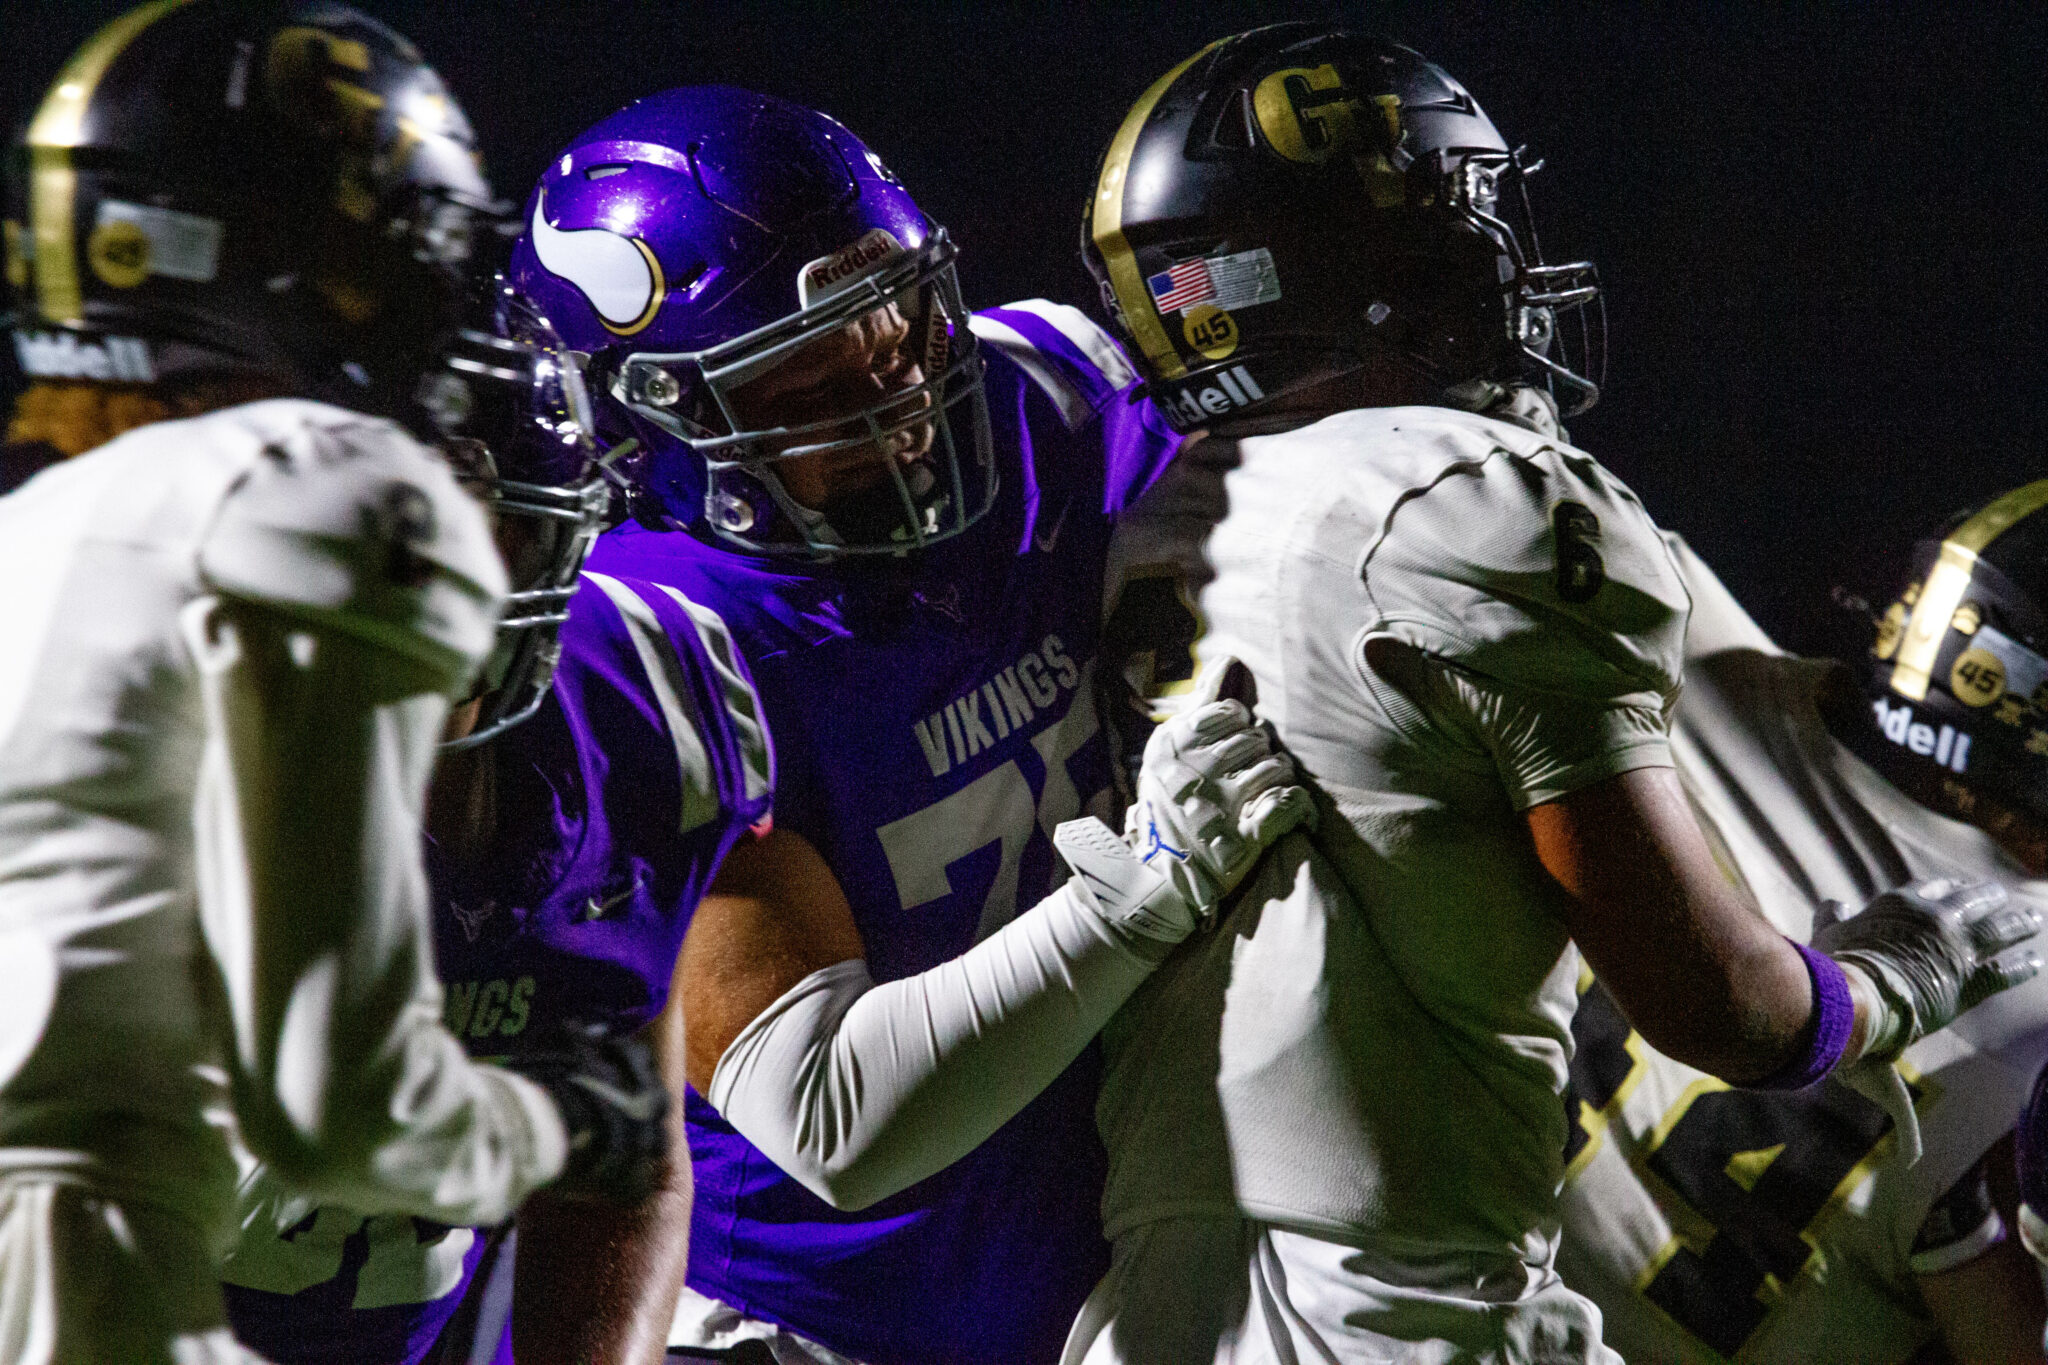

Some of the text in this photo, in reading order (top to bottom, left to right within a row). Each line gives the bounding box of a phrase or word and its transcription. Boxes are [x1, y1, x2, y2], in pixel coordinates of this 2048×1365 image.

[1192, 312, 1231, 347] 45
[1552, 500, 1605, 604] 6
[914, 633, 1078, 777] VIKINGS
[1957, 660, 2000, 695] 45
